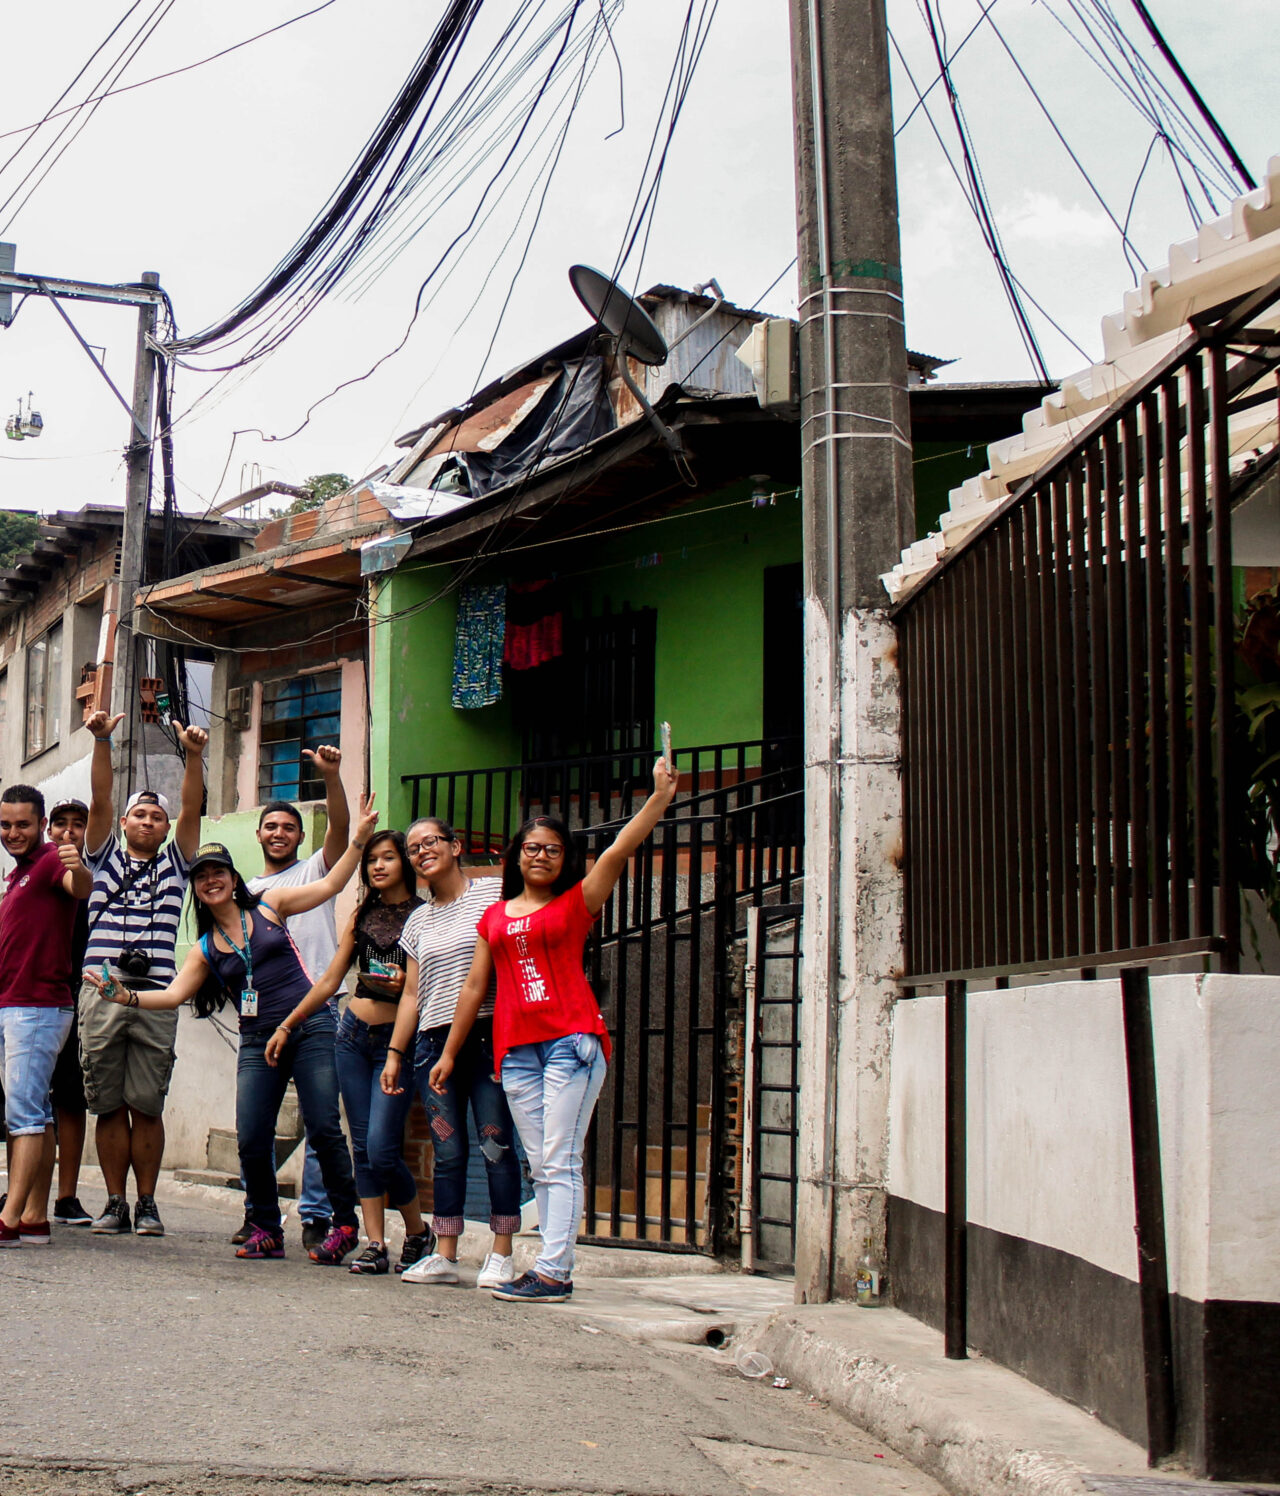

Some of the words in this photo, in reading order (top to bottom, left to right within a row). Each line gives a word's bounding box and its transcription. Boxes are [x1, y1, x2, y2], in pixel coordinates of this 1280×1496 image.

[516, 935, 528, 956] OF
[518, 958, 541, 980] THE
[522, 980, 550, 1002] LOVE
